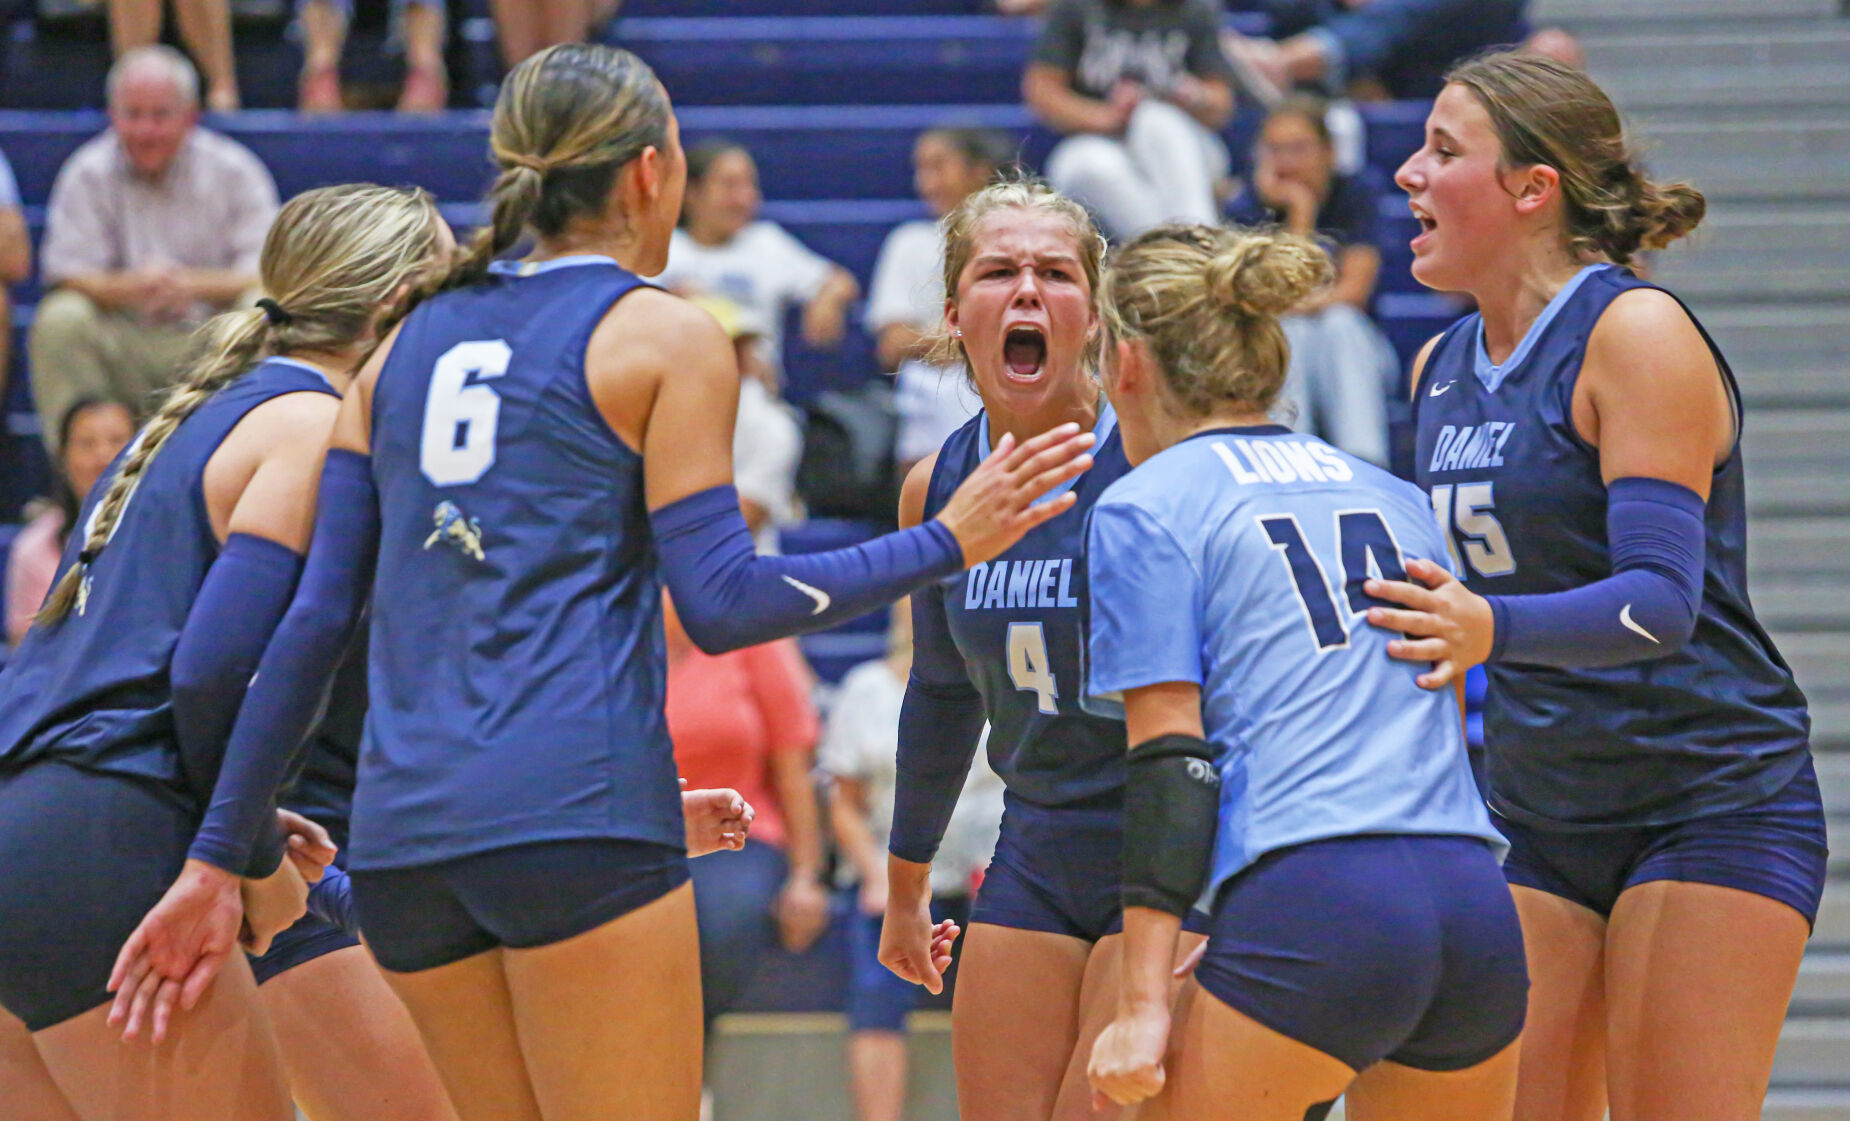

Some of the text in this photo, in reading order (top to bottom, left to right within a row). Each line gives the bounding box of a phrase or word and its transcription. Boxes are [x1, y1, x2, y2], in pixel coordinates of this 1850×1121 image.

[419, 338, 514, 488] 6
[1429, 421, 1516, 472] DANIEL
[1210, 438, 1354, 486] LIONS
[1431, 481, 1518, 581] 15
[964, 558, 1079, 610] DANIEL
[1254, 508, 1422, 654] 14
[1006, 621, 1060, 715] 4
